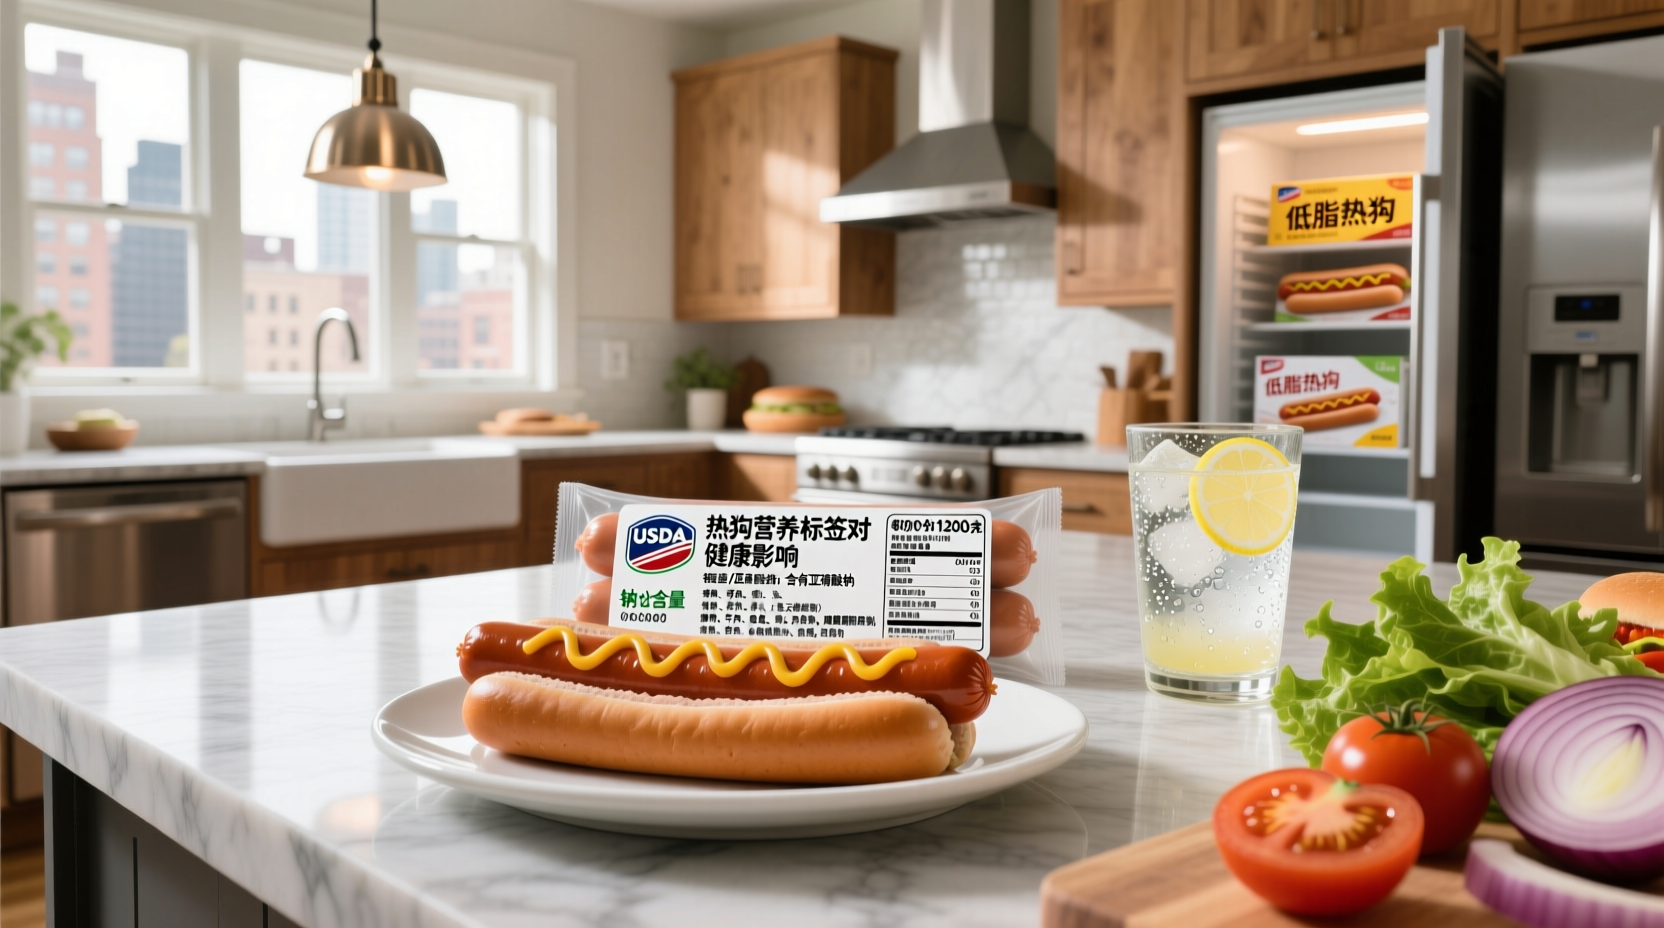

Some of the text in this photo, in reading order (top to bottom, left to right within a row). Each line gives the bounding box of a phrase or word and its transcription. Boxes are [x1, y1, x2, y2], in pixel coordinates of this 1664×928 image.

[1286, 196, 1395, 231] 低脂热狗
[1266, 370, 1339, 397] 低脂热狗
[633, 527, 686, 545] USDA
[706, 514, 872, 542] 热狗营养标签对
[705, 542, 799, 568] 健康影响
